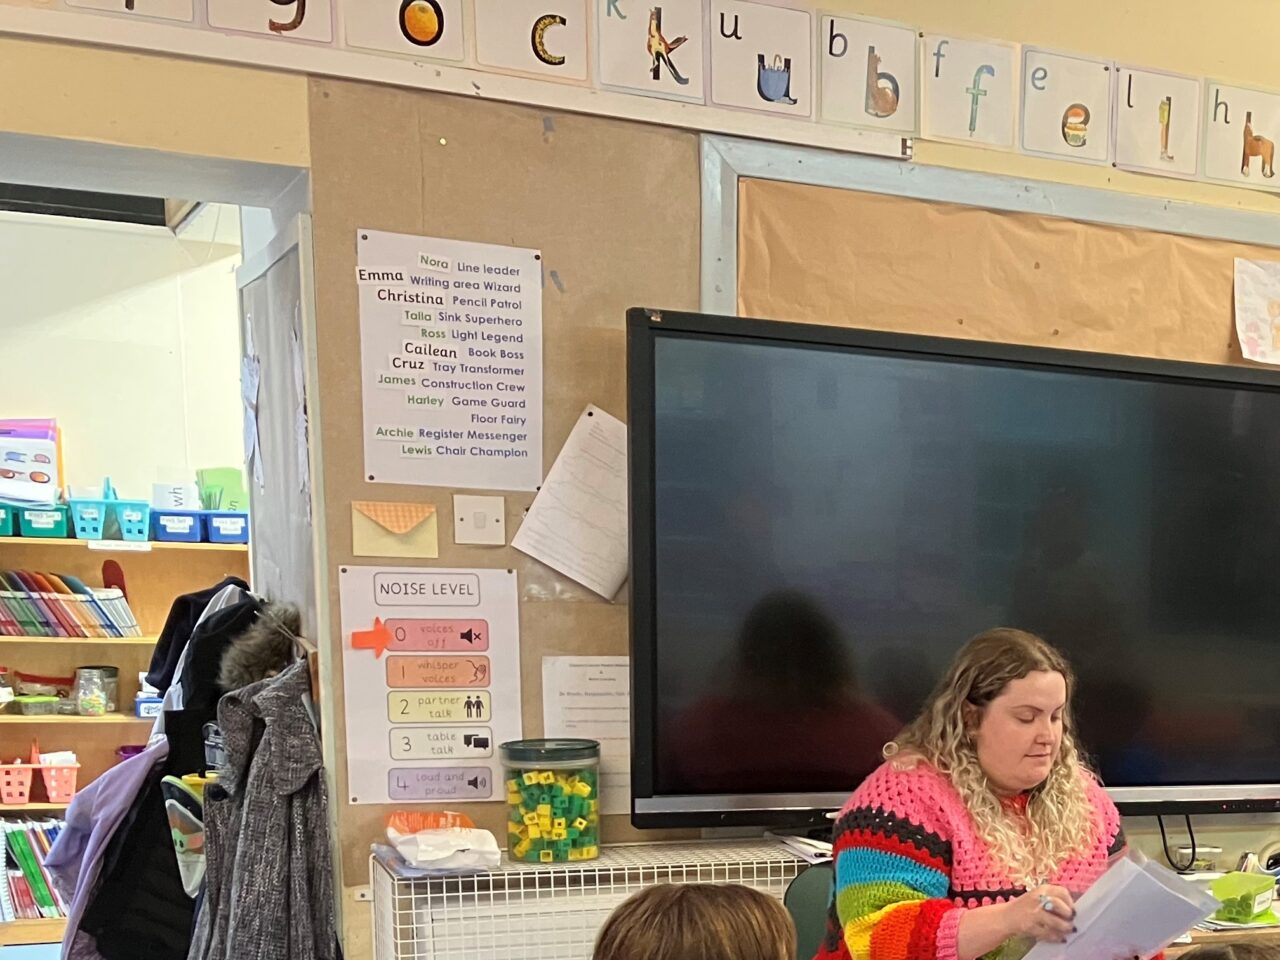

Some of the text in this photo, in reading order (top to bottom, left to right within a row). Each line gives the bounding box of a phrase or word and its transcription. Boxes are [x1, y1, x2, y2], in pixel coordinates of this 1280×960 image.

[398, 0, 444, 46] o
[720, 12, 742, 39] u
[531, 14, 566, 66] c
[648, 6, 689, 85] k
[829, 19, 848, 57] b
[933, 40, 949, 77] f
[757, 54, 798, 104] u
[865, 46, 899, 118] b
[1032, 67, 1048, 90] e
[966, 64, 994, 137] f
[1213, 89, 1231, 124] h
[1062, 103, 1090, 147] e
[1241, 111, 1275, 178] h
[421, 256, 520, 276] Nora Line leader
[359, 269, 403, 280] Emma
[411, 276, 449, 289] Writing
[484, 282, 520, 293] Wizard
[378, 289, 522, 309] Christina Pencil Patrol
[439, 312, 461, 322] Sink
[465, 314, 522, 326] Superhero
[422, 329, 523, 343] Ross Light Legend
[405, 343, 524, 359] Cailean Book Boss
[393, 358, 524, 375] Cruz Tray Transformer
[378, 374, 525, 392] James Construction Crew
[408, 395, 525, 408] Harley Game Guard
[471, 414, 526, 426] Floor Fairy
[376, 427, 527, 442] Archie Register Messenger
[402, 445, 528, 458] Lewis Chair Champion
[380, 582, 474, 595] NOISE LEVEL
[421, 624, 454, 633] voices
[427, 638, 446, 648] off
[418, 661, 459, 670] whisper
[422, 674, 455, 683] voices
[400, 699, 409, 715] 2
[418, 695, 460, 708] partner
[429, 710, 452, 718] talk
[402, 736, 411, 752] 3
[427, 733, 456, 741] table
[431, 745, 454, 754] talk
[397, 776, 408, 790] 4
[416, 772, 464, 781] loud and
[425, 786, 456, 795] proud
